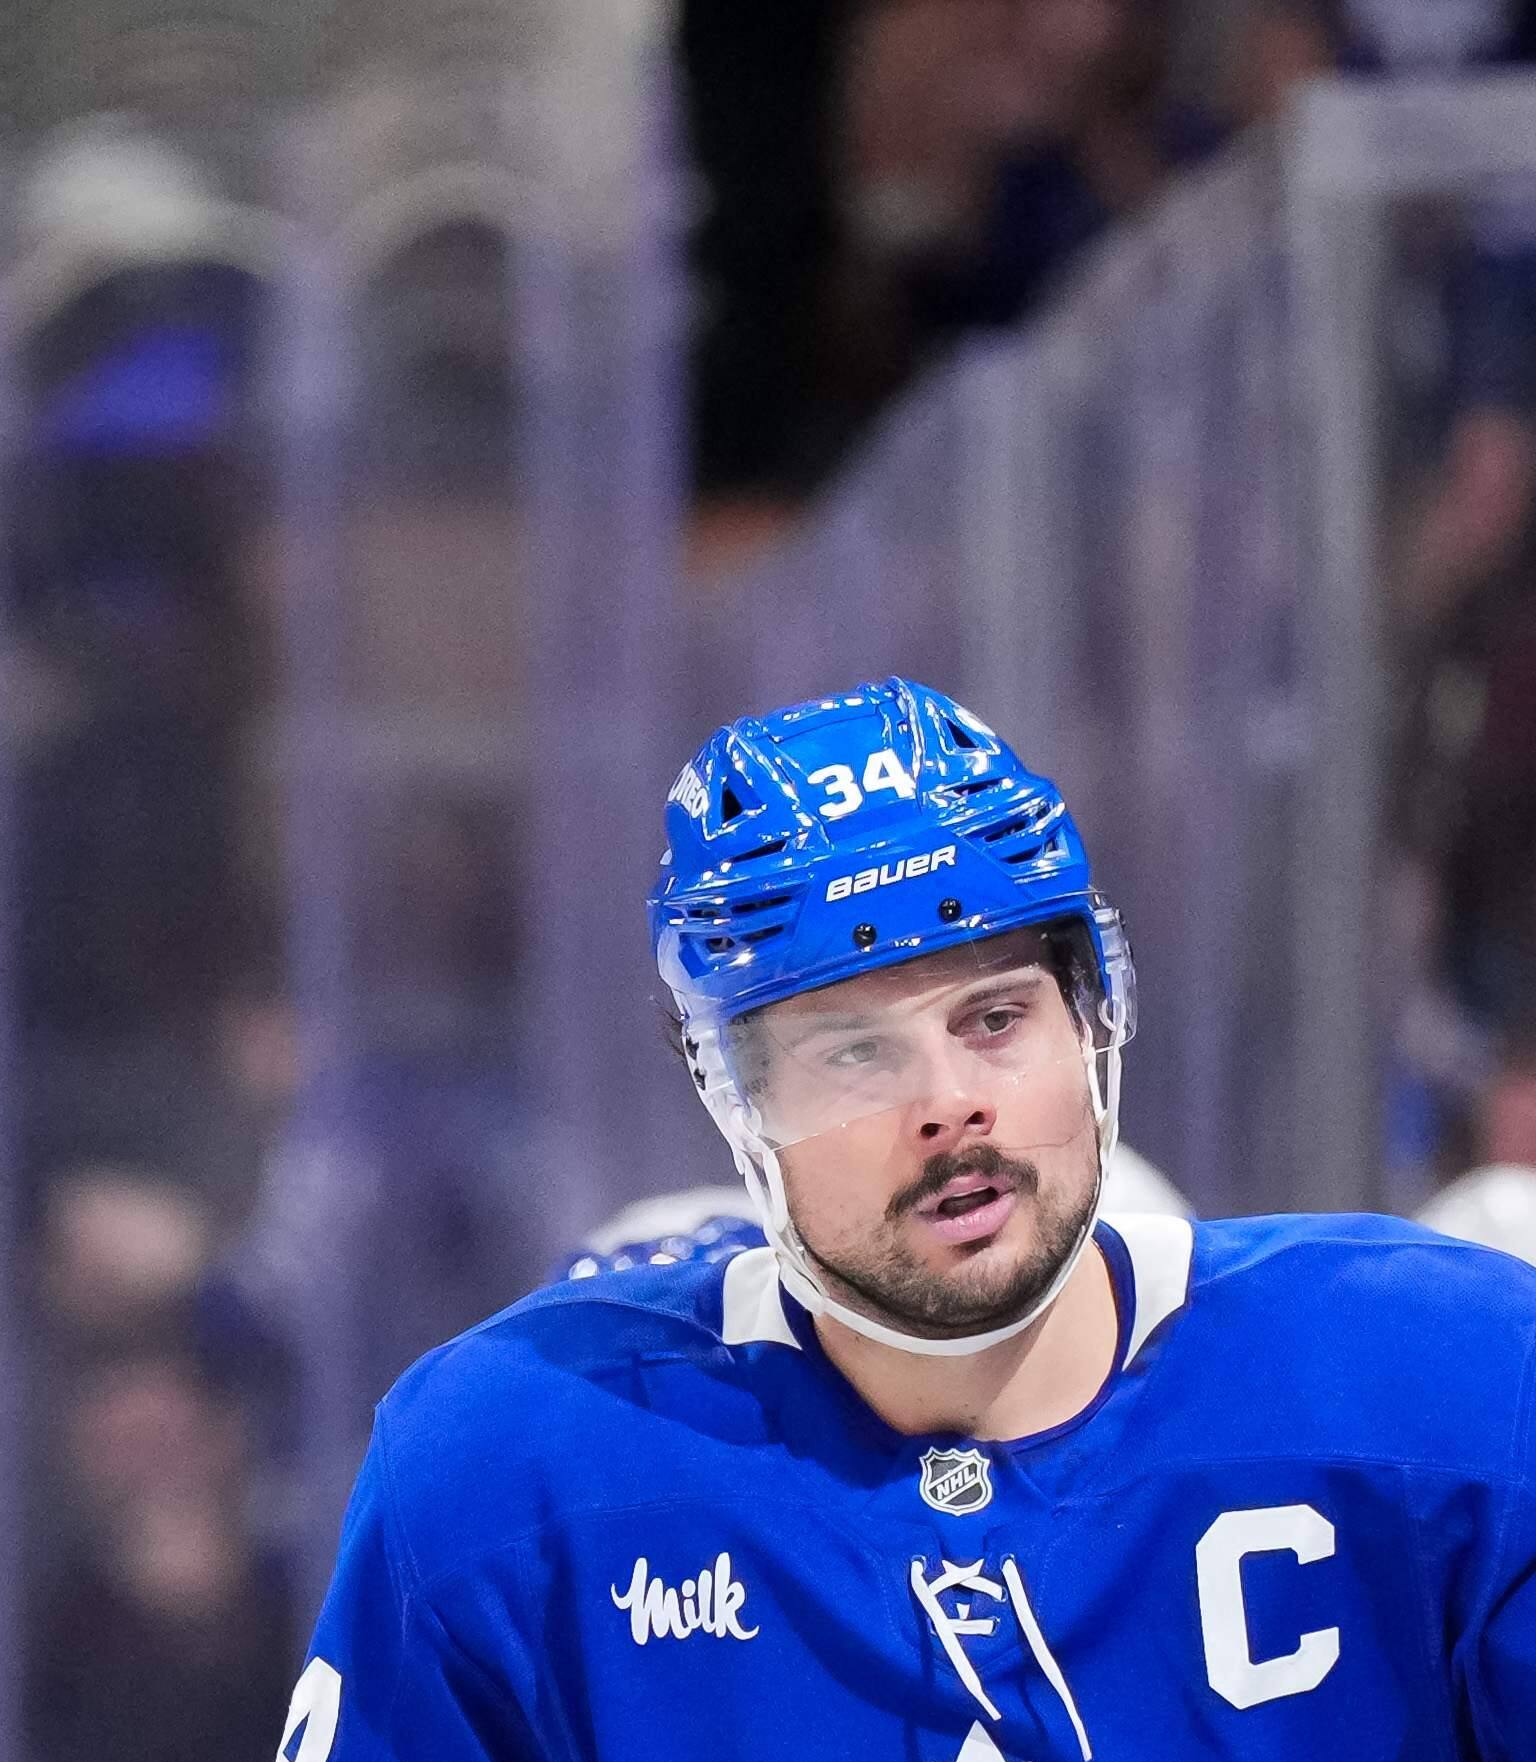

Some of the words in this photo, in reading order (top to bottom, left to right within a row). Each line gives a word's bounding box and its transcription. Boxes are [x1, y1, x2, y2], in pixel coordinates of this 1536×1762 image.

[806, 748, 917, 819] 34
[825, 844, 958, 903] BAUER
[935, 1466, 976, 1501] NHL
[610, 1551, 760, 1646] Milk
[1195, 1503, 1340, 1710] C
